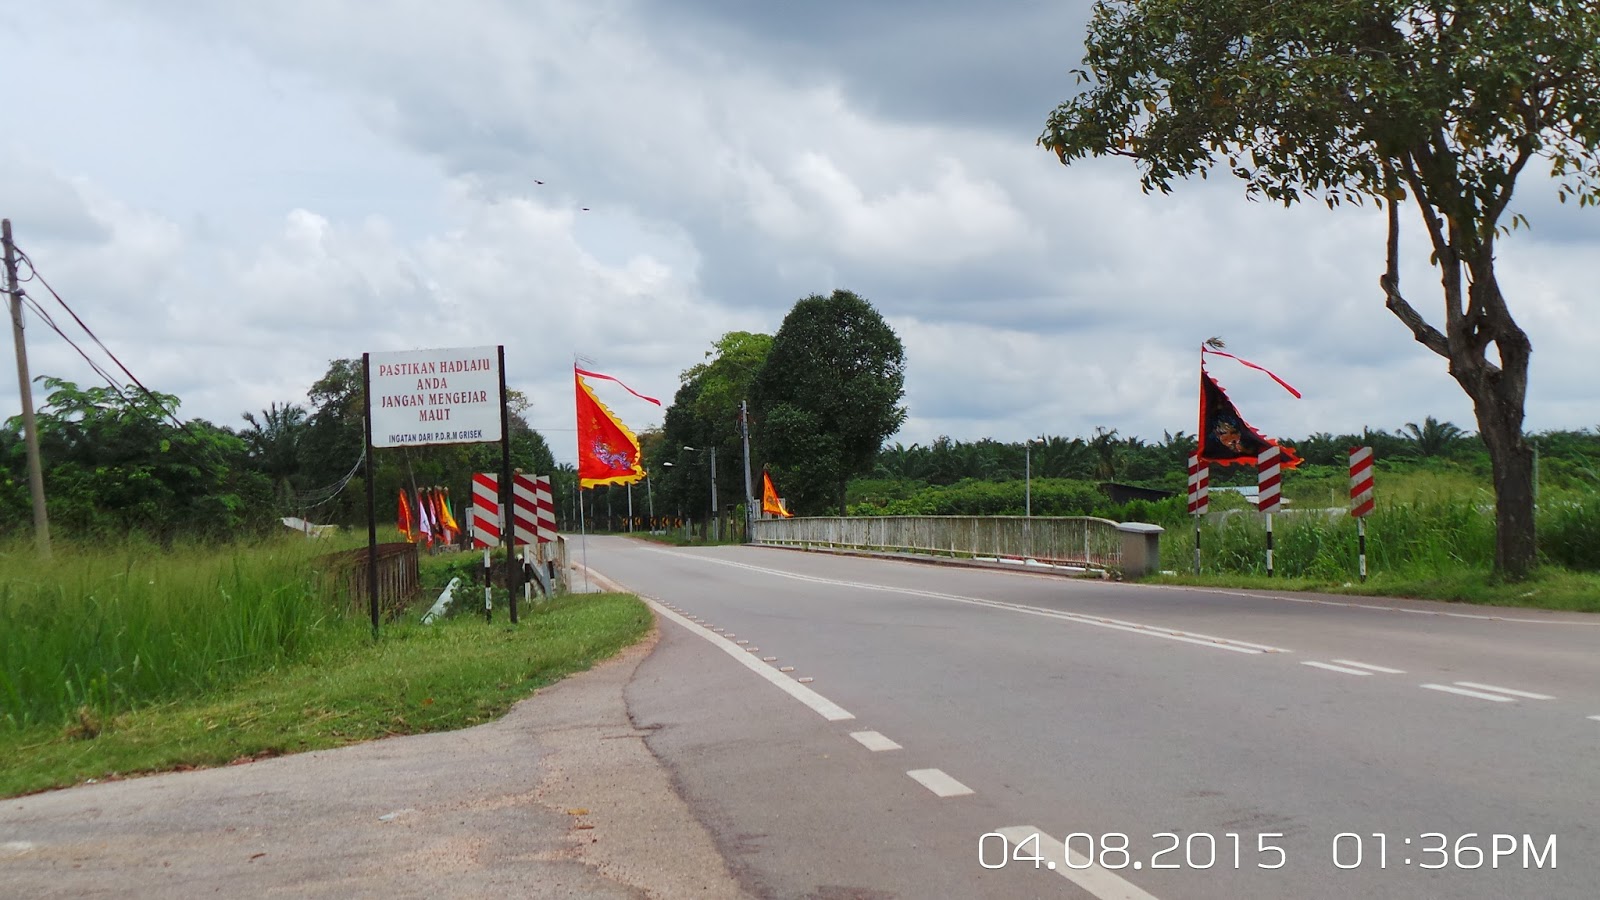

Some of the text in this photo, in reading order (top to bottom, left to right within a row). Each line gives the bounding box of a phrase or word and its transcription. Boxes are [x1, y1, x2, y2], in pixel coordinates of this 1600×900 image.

[379, 359, 490, 376] PASTIKAN HADLAJU
[417, 377, 447, 390] ANDA
[382, 391, 487, 408] JANGAN MENGEJAR
[419, 409, 450, 421] MAUT
[389, 434, 417, 443] INGATAN
[418, 433, 433, 442] DARI
[459, 430, 482, 439] GRISEK
